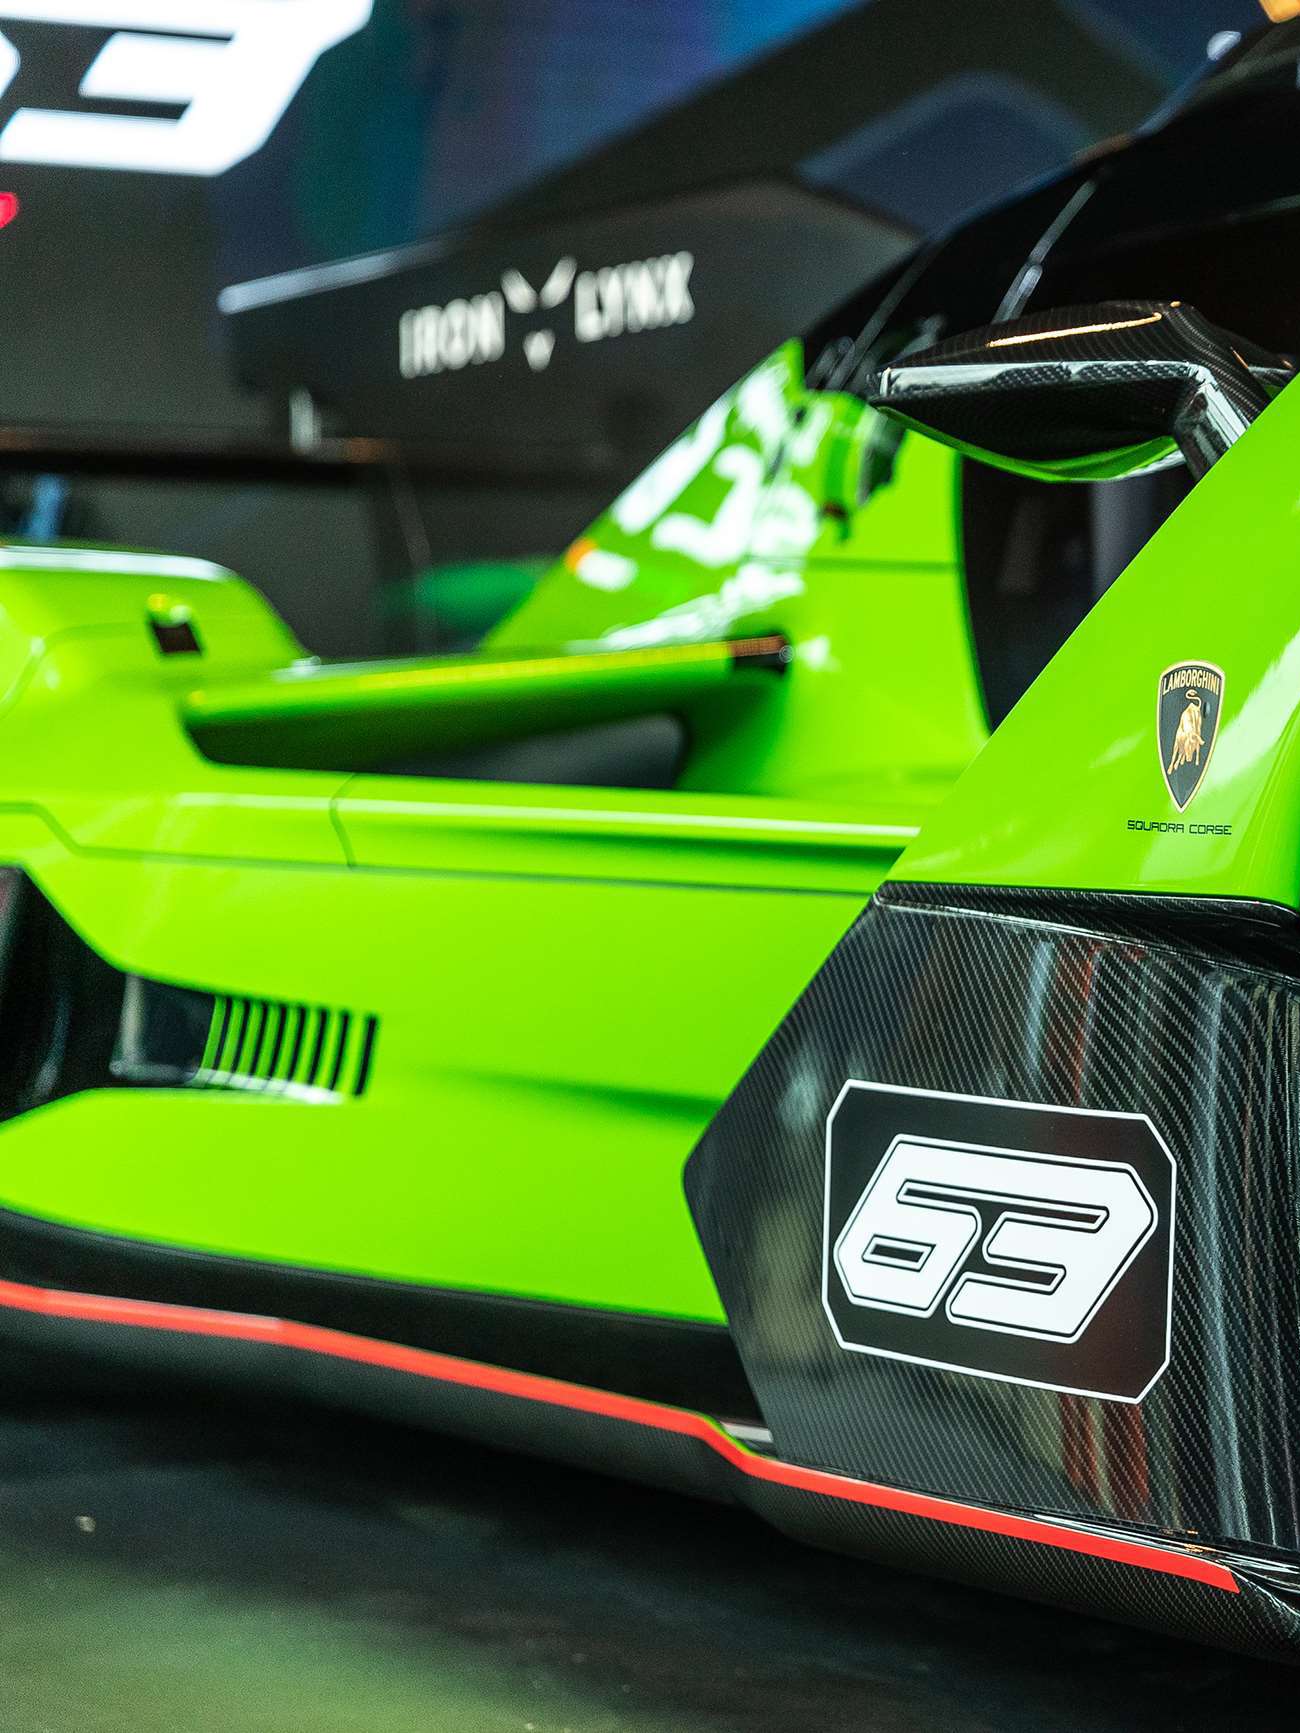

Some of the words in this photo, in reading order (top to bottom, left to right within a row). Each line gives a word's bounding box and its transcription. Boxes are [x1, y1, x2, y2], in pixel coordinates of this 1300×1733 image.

[0, 0, 374, 177] 3
[399, 291, 505, 379] IRON
[574, 250, 695, 342] LYNX
[1162, 669, 1221, 696] LAMBORGHINI
[1127, 819, 1185, 833] SQUADRA
[1188, 823, 1233, 836] CORSE
[833, 1133, 1158, 1344] 63
